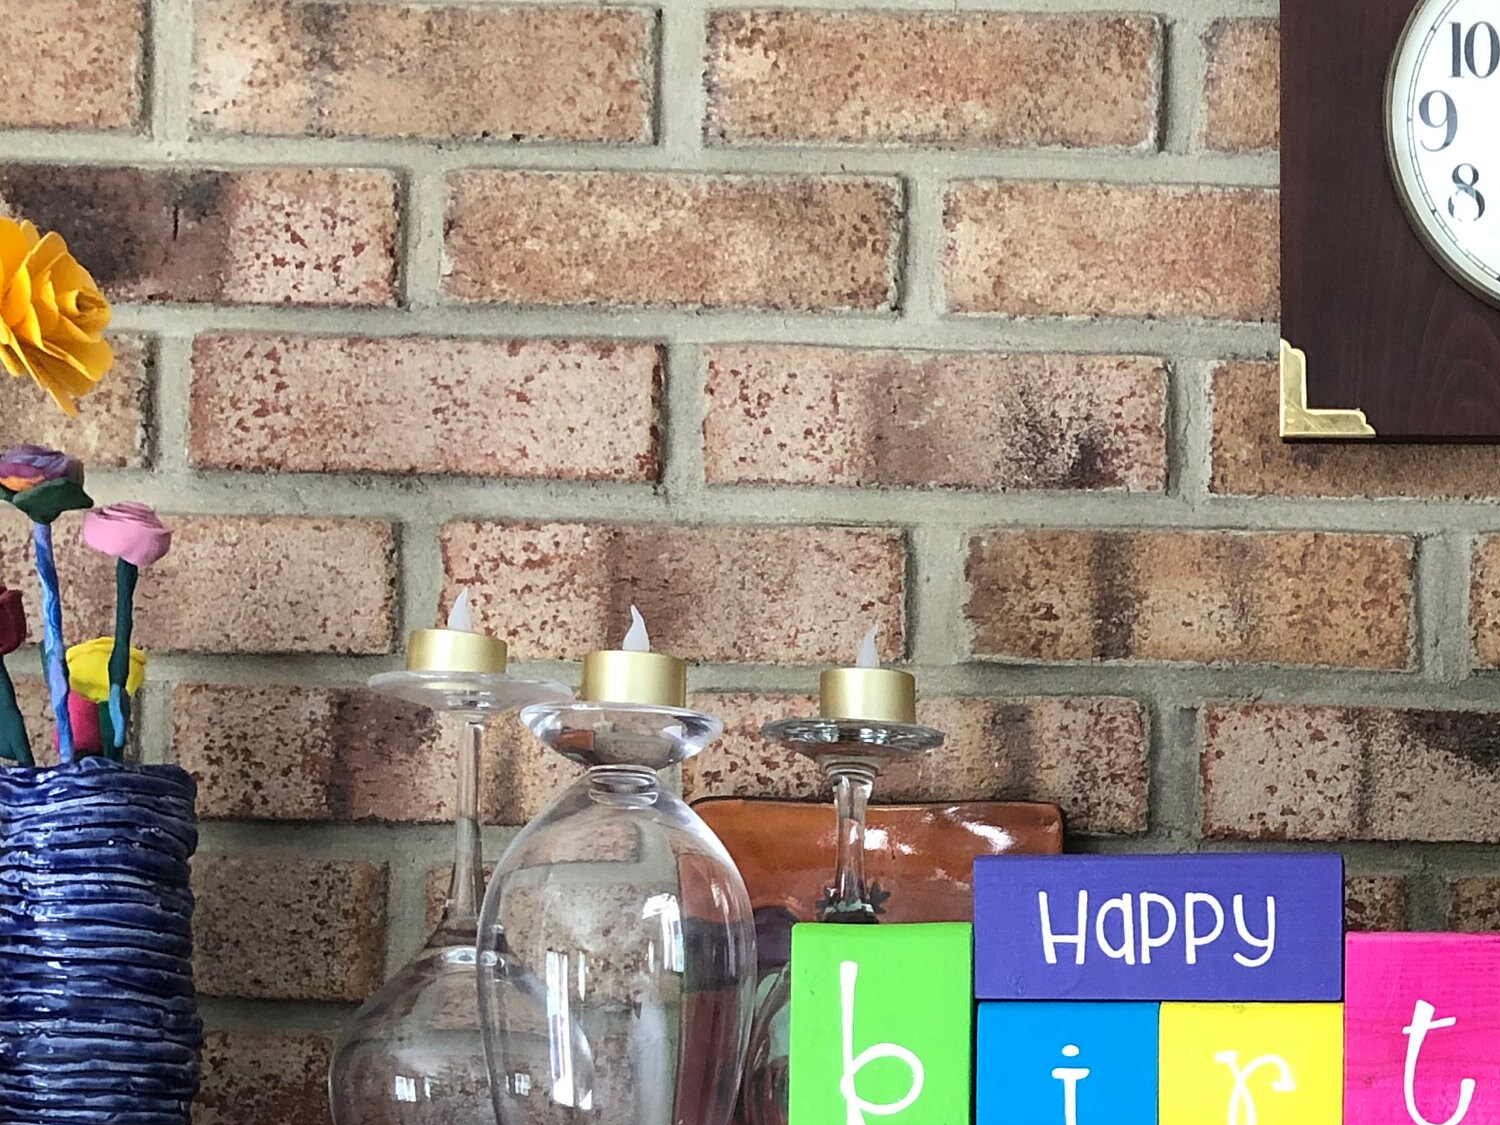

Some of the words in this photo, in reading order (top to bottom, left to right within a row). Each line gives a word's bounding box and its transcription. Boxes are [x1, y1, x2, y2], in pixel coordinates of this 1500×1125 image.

[1448, 21, 1500, 78] 10
[1418, 90, 1458, 152] 9
[1447, 163, 1486, 222] 8
